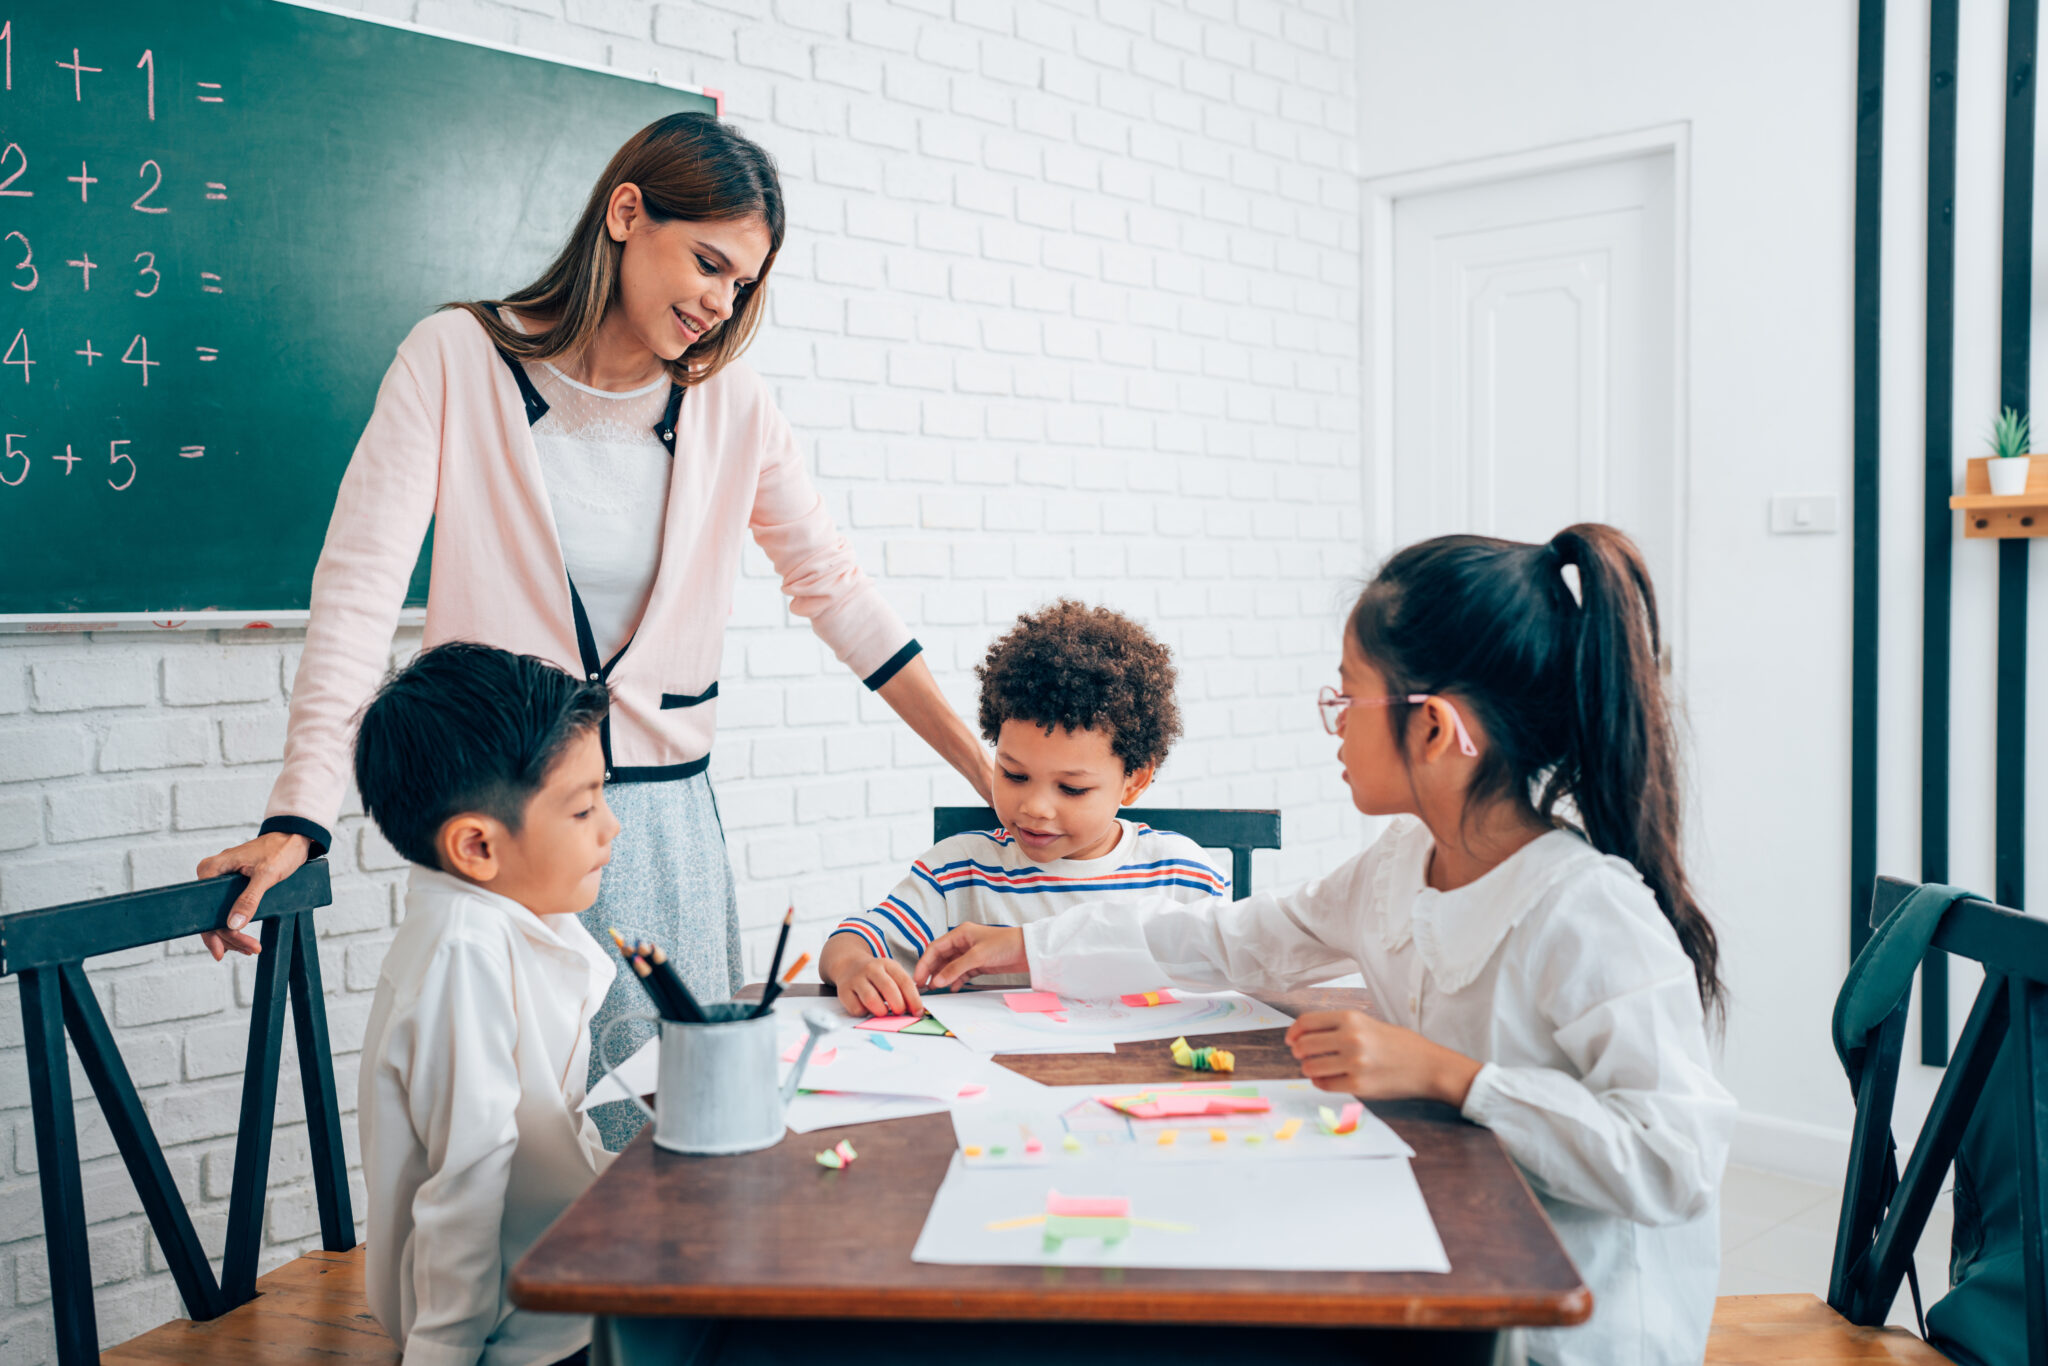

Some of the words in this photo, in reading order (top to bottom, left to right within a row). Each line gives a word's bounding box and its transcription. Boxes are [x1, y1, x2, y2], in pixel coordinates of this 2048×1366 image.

[0, 20, 12, 90] 1
[55, 48, 103, 102] +
[136, 49, 156, 121] 1
[196, 82, 224, 103] =
[0, 142, 35, 197] 2
[67, 160, 98, 203] +
[131, 159, 170, 214] 2
[205, 182, 228, 200] =
[4, 230, 39, 291] 3
[66, 252, 98, 291] +
[134, 251, 160, 298] 3
[200, 271, 223, 294] =
[2, 328, 37, 384] 4
[75, 339, 103, 367] +
[121, 334, 160, 387] 4
[195, 346, 219, 361] =
[0, 433, 30, 487] 5
[52, 444, 82, 476] +
[107, 440, 137, 491] 5
[178, 445, 206, 458] =
